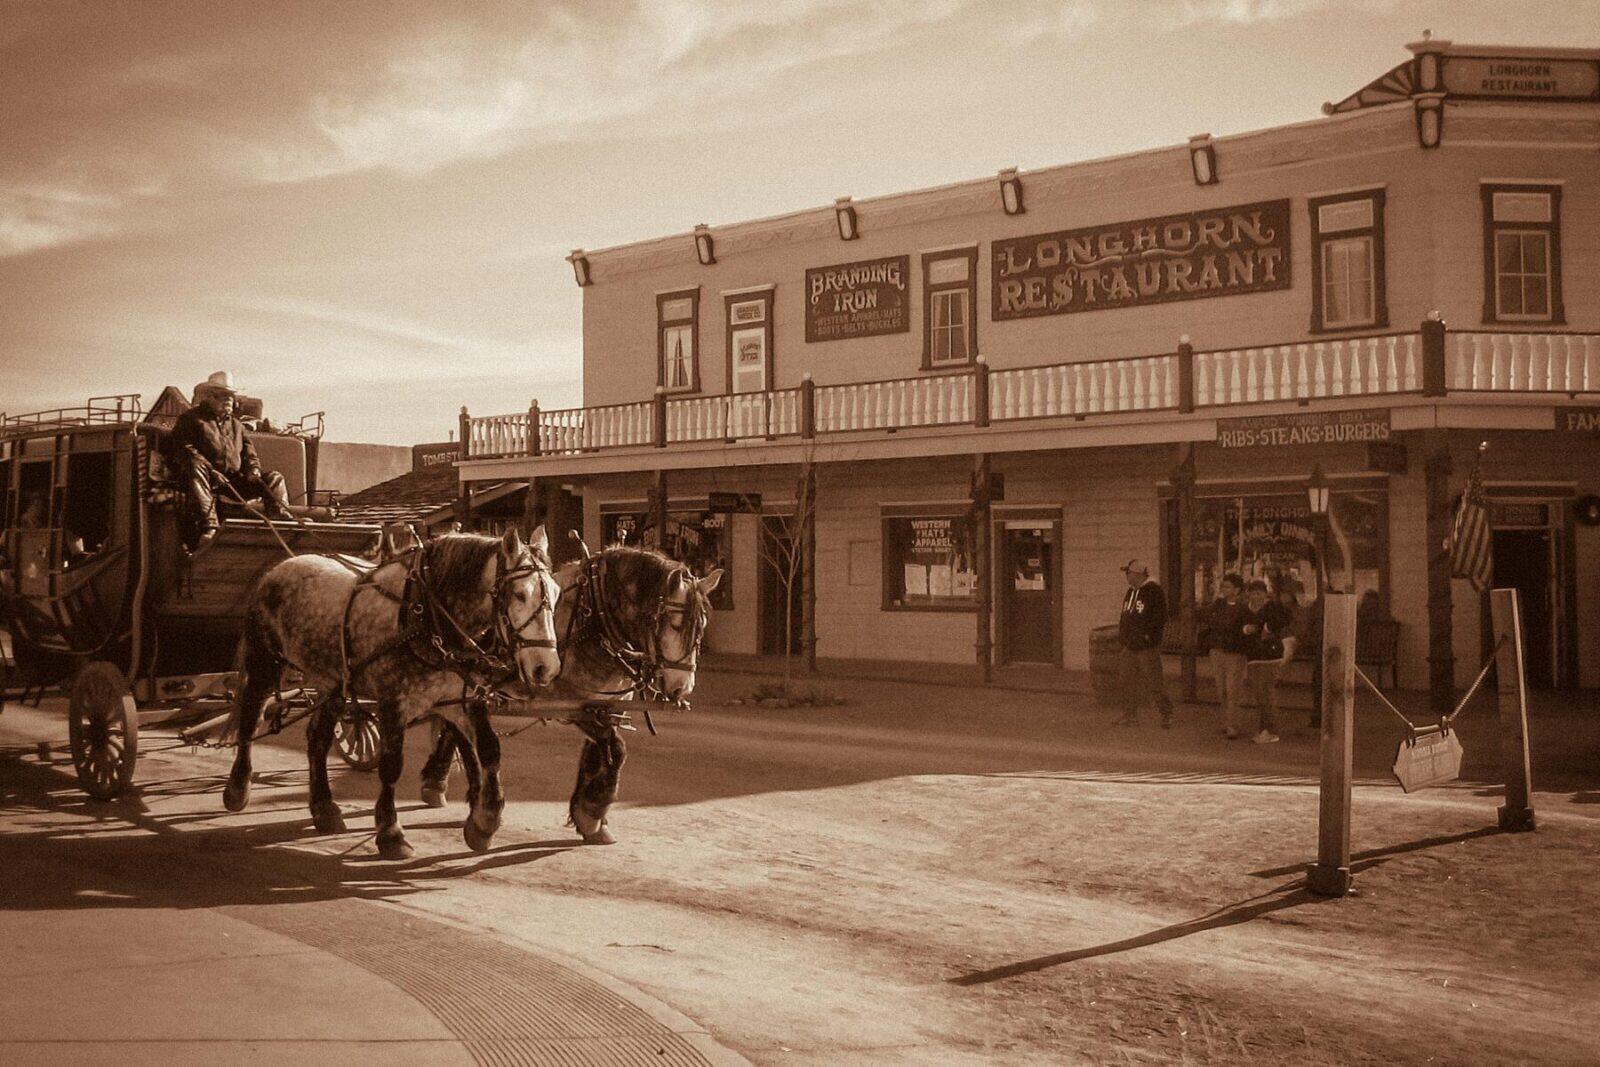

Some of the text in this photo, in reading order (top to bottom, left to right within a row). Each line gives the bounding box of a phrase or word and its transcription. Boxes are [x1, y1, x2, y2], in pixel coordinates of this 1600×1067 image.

[1489, 64, 1550, 76] LONGHORN
[1481, 79, 1557, 91] RESTAURANT
[1000, 211, 1274, 277] LONGHORN
[810, 262, 905, 305] BRANDING
[998, 247, 1281, 313] RESTAURANT
[834, 288, 878, 313] IRON
[1222, 421, 1389, 448] RIBS STEAKS BURGERS
[915, 537, 953, 547] APPAREL
